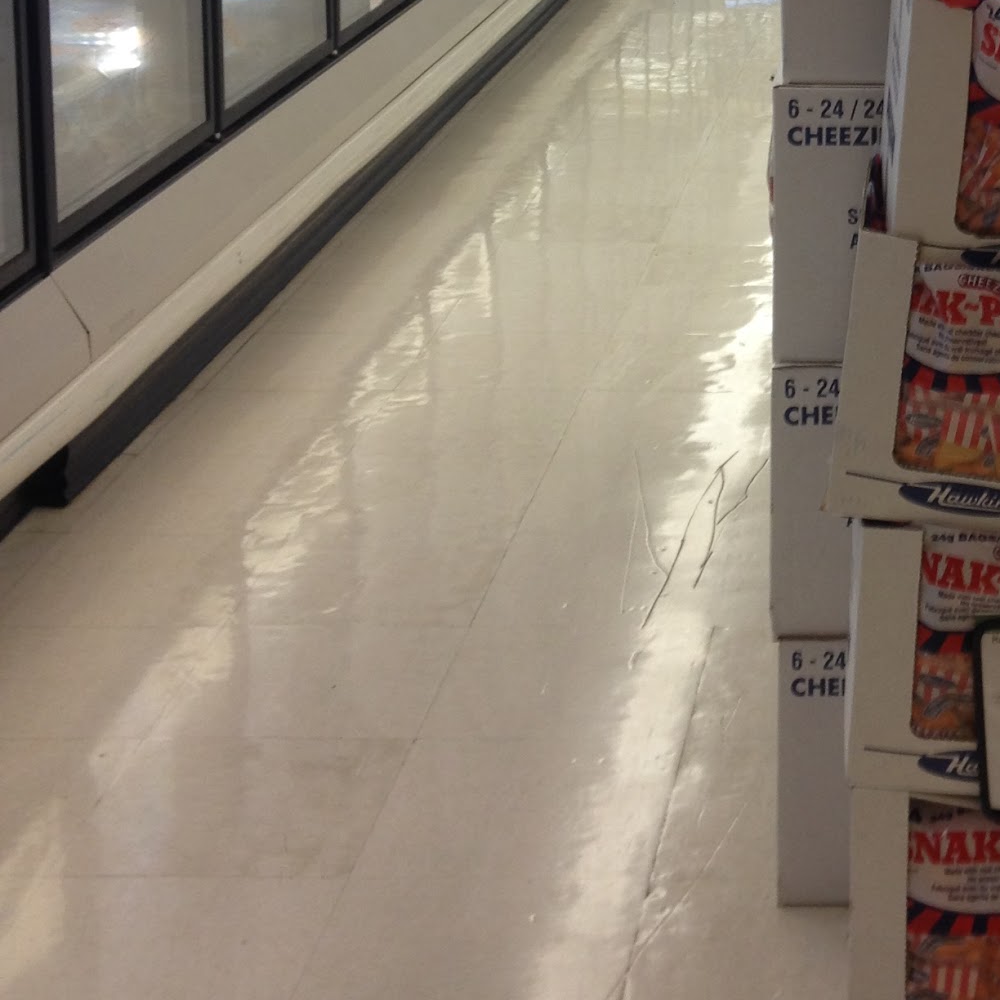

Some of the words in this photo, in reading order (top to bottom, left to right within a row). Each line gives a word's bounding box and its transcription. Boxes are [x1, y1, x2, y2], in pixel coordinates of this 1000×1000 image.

[788, 99, 800, 119] 6
[820, 99, 844, 119] 24
[787, 127, 882, 146] CHEEZI
[785, 378, 796, 398] 6
[817, 378, 840, 398] 24
[791, 651, 803, 670] 6
[823, 651, 846, 670] 24
